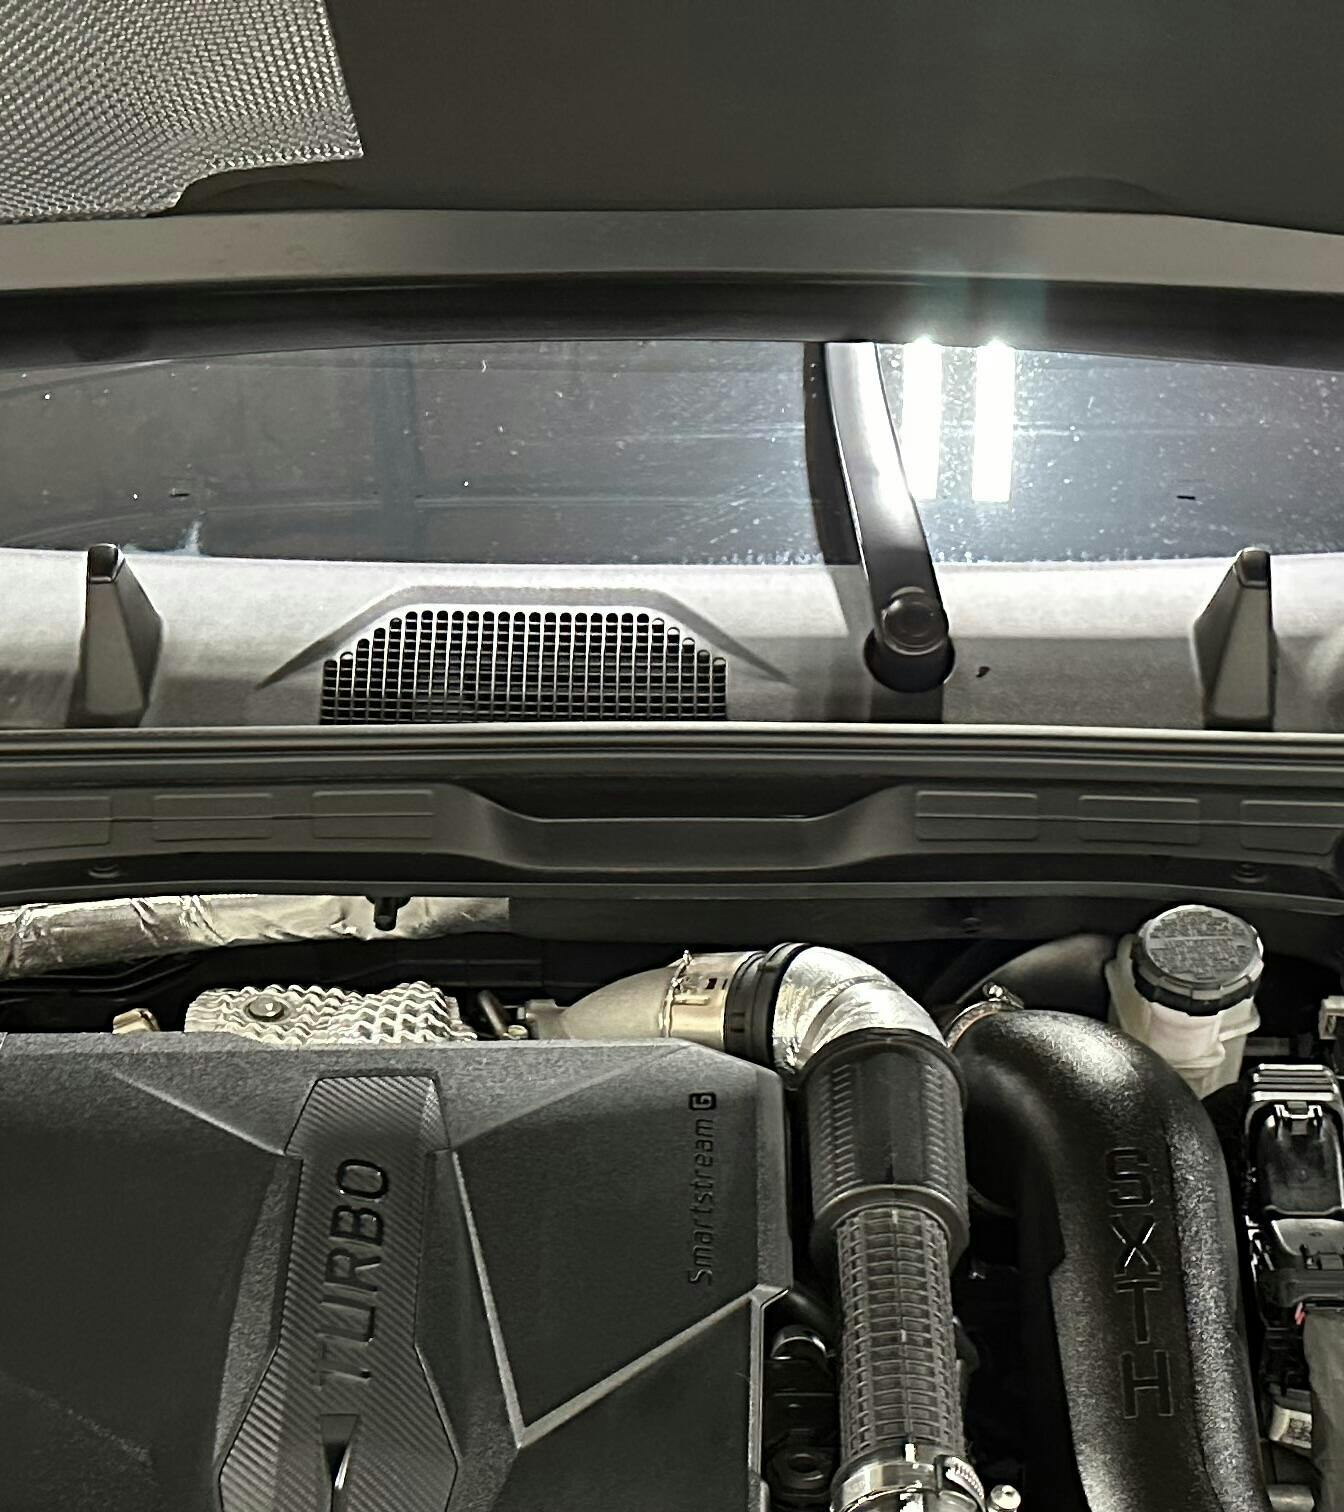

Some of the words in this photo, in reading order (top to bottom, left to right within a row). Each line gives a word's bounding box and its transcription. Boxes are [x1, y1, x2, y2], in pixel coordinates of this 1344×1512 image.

[690, 1093, 716, 1110] G
[316, 1159, 389, 1388] TURBO
[689, 1119, 714, 1285] Smartstream
